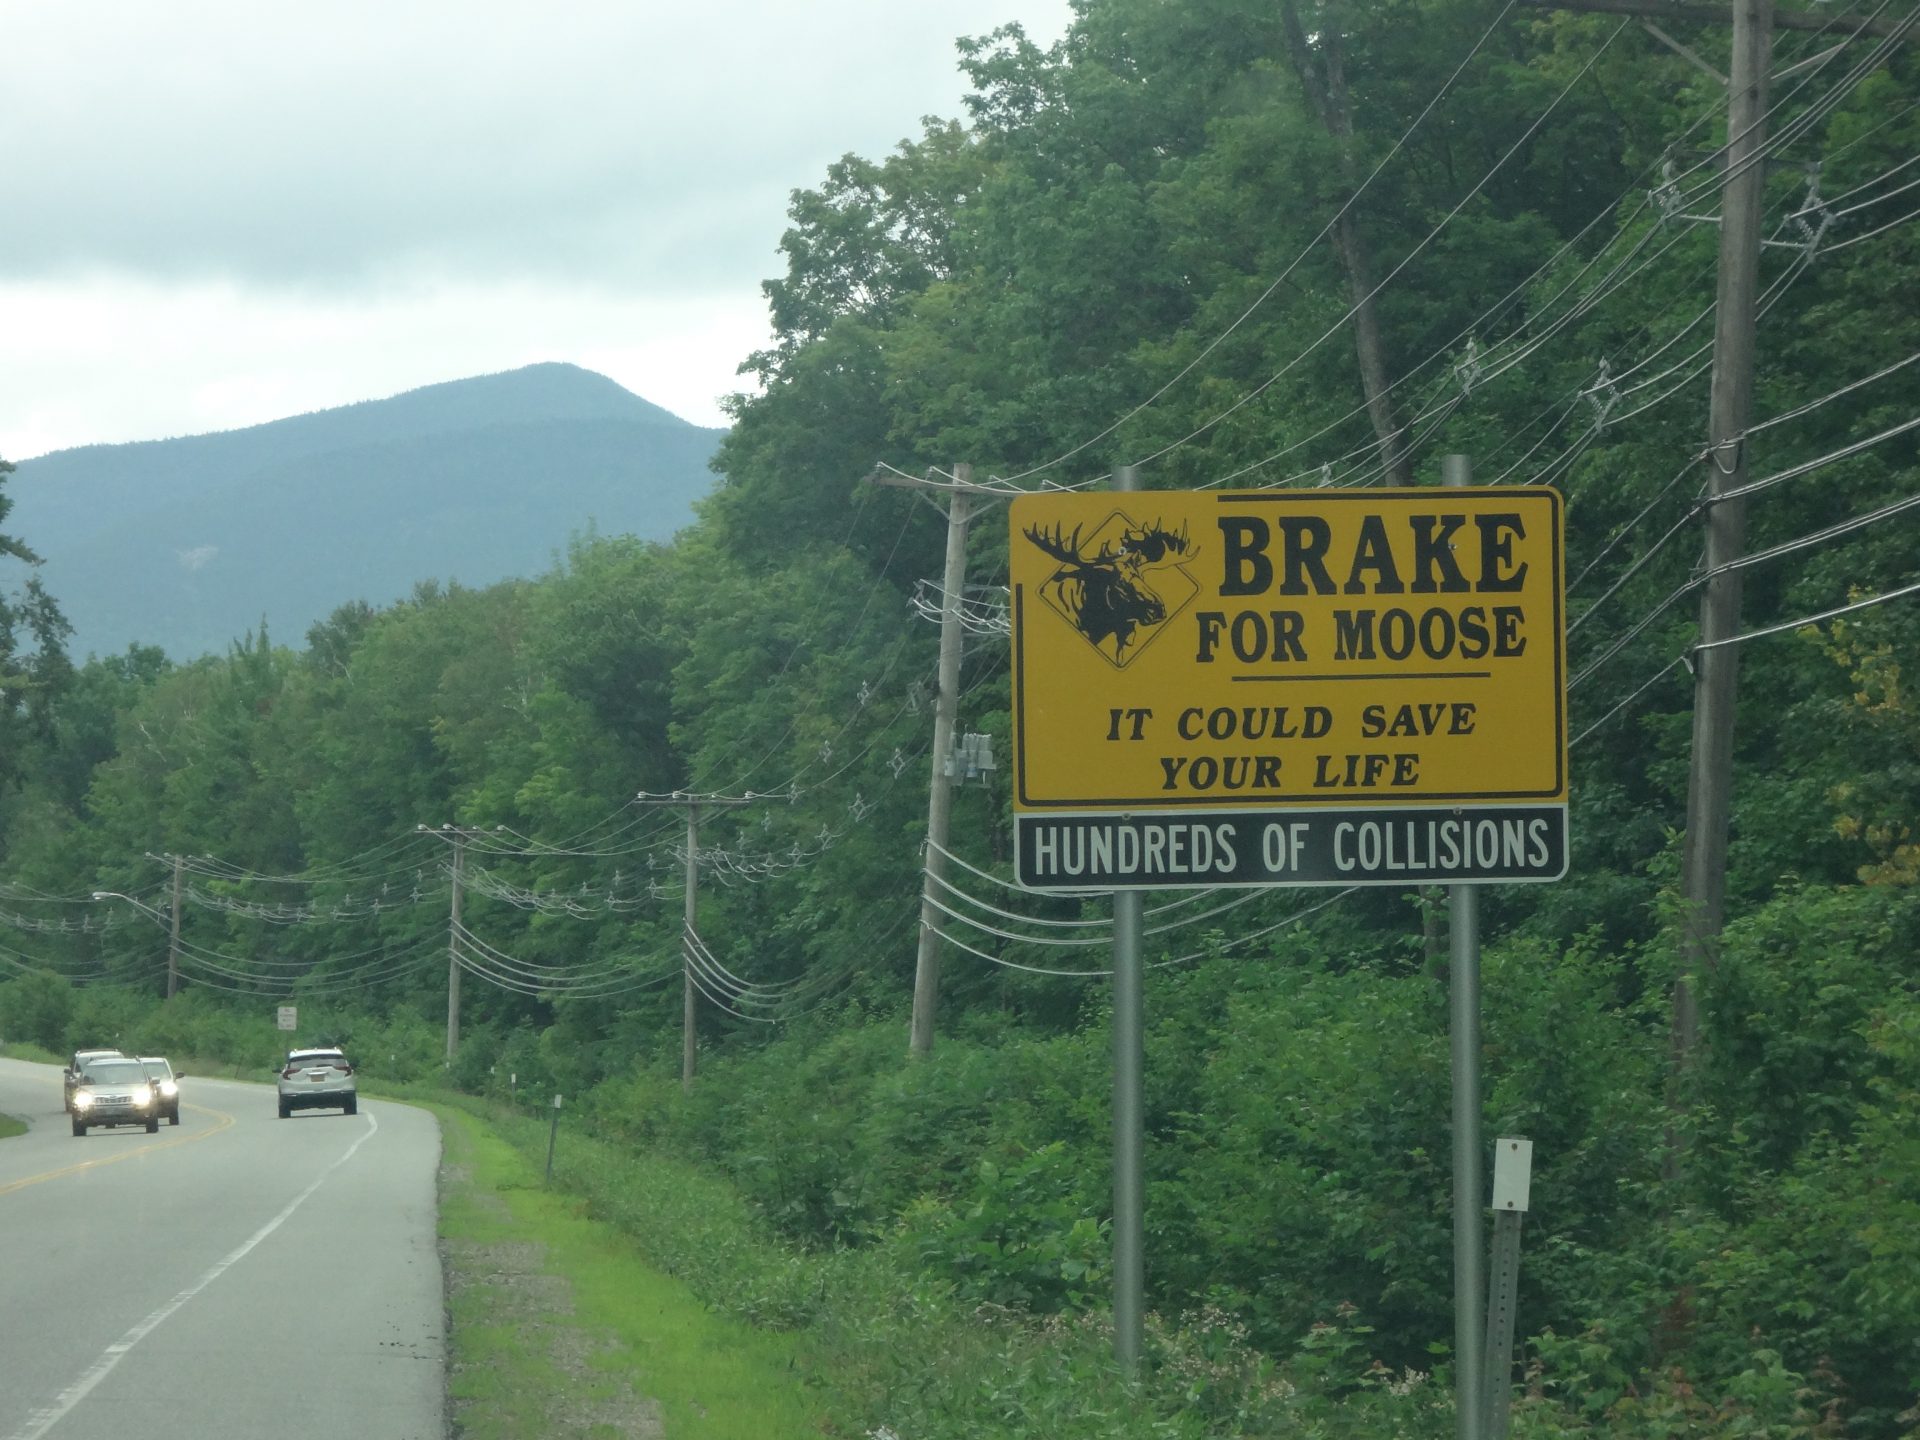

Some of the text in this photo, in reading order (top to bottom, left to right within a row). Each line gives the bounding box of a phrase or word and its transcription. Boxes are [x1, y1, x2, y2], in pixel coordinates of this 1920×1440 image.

[1217, 513, 1528, 596] BRAKE
[1196, 607, 1527, 663] FOR MOOSE
[1106, 703, 1477, 741] IT COULD SAVE
[1160, 753, 1420, 791] YOUR LIFE
[1035, 818, 1550, 875] HUNDREDS OF COLLISIONS
